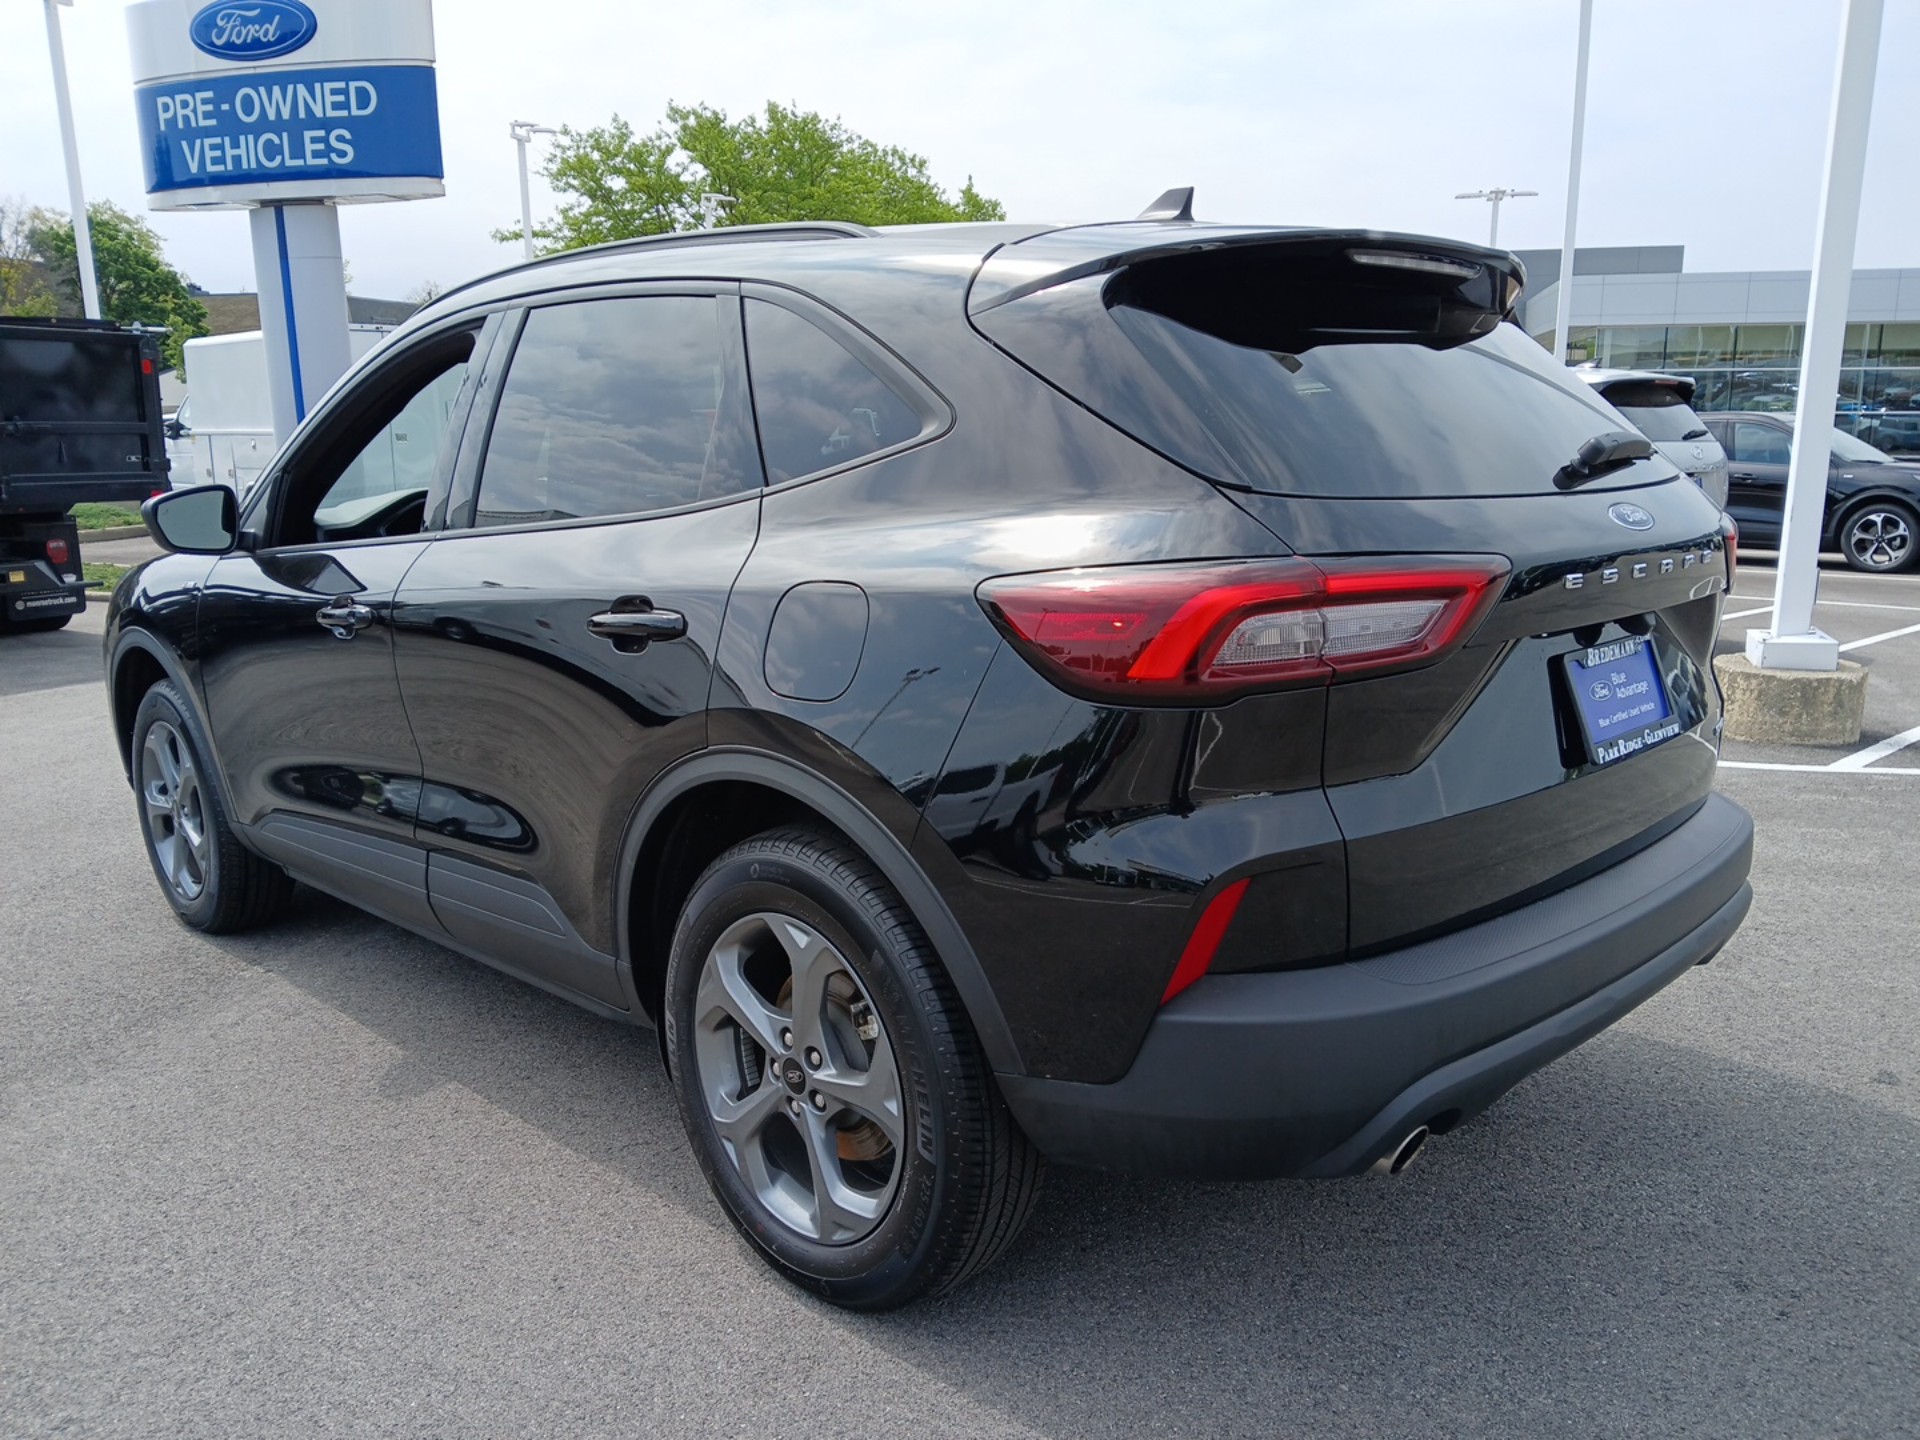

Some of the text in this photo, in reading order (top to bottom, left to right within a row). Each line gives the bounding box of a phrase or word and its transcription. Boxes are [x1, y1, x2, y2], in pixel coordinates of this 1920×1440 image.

[211, 8, 280, 46] Ford
[156, 80, 378, 131] PRE-OWNED
[181, 128, 355, 174] VEHICLES
[1563, 550, 1713, 589] ESCAPE
[1610, 672, 1627, 685] Blue
[1616, 680, 1649, 699] Advantage
